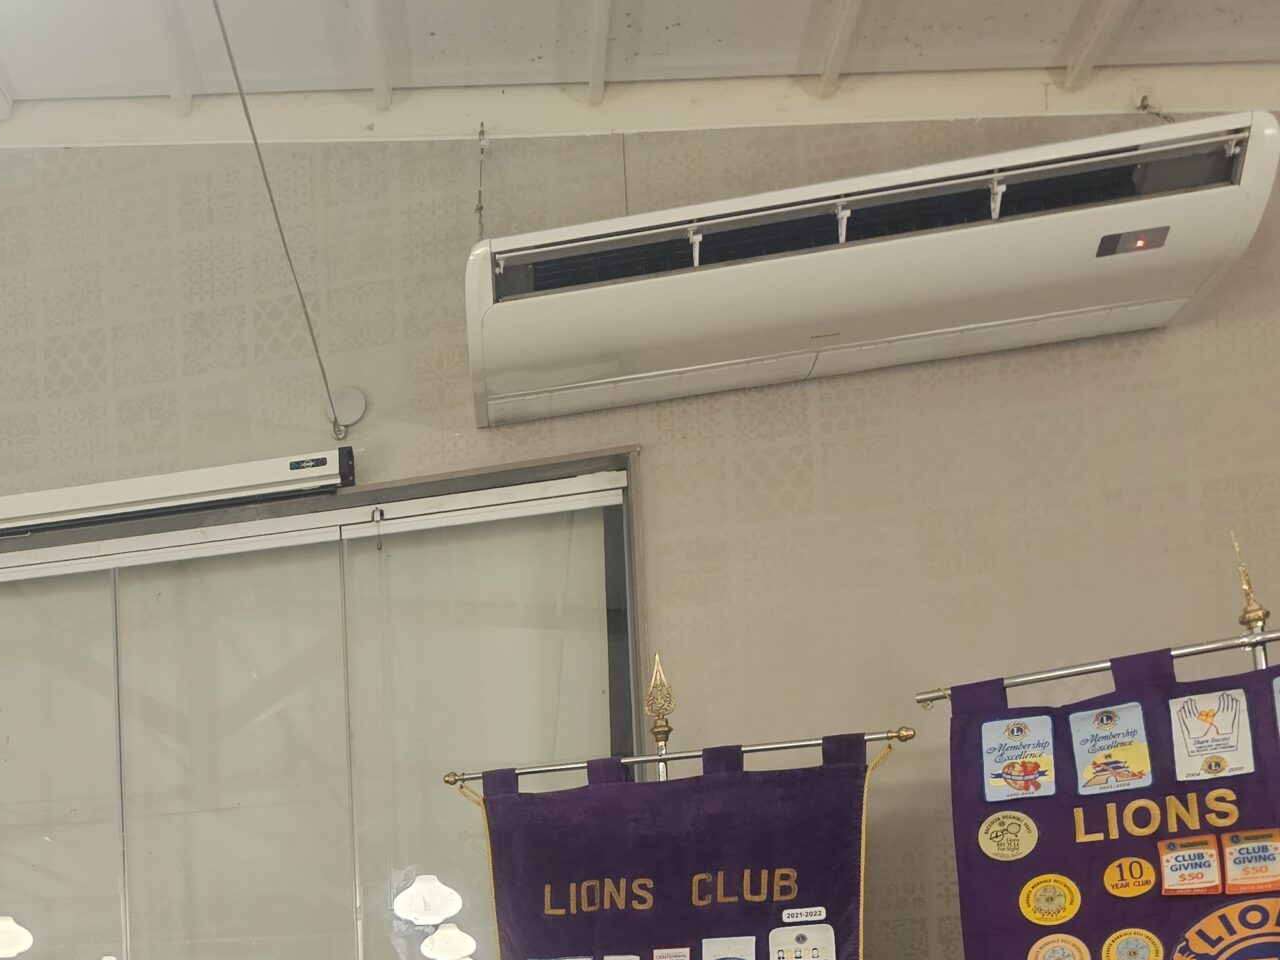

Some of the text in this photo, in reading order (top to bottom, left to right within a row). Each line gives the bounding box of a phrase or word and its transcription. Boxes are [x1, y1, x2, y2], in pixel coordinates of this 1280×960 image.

[1080, 729, 1138, 745] Membership
[986, 741, 1049, 754] Membership
[1088, 740, 1133, 753] Excellence
[994, 751, 1044, 763] Excellence
[1073, 788, 1239, 843] LIONS
[1238, 845, 1269, 856] CLUB
[1175, 853, 1204, 863] CLUB
[1233, 853, 1276, 865] GIVING
[1116, 860, 1144, 882] 10
[1170, 860, 1212, 872] GIVING
[1242, 865, 1269, 876] $50
[1179, 872, 1204, 882] $50
[1110, 880, 1130, 890] YEAR
[543, 868, 798, 916] LIONS CLUB
[786, 911, 822, 919] 2021-2022
[1195, 905, 1280, 948] LIO
